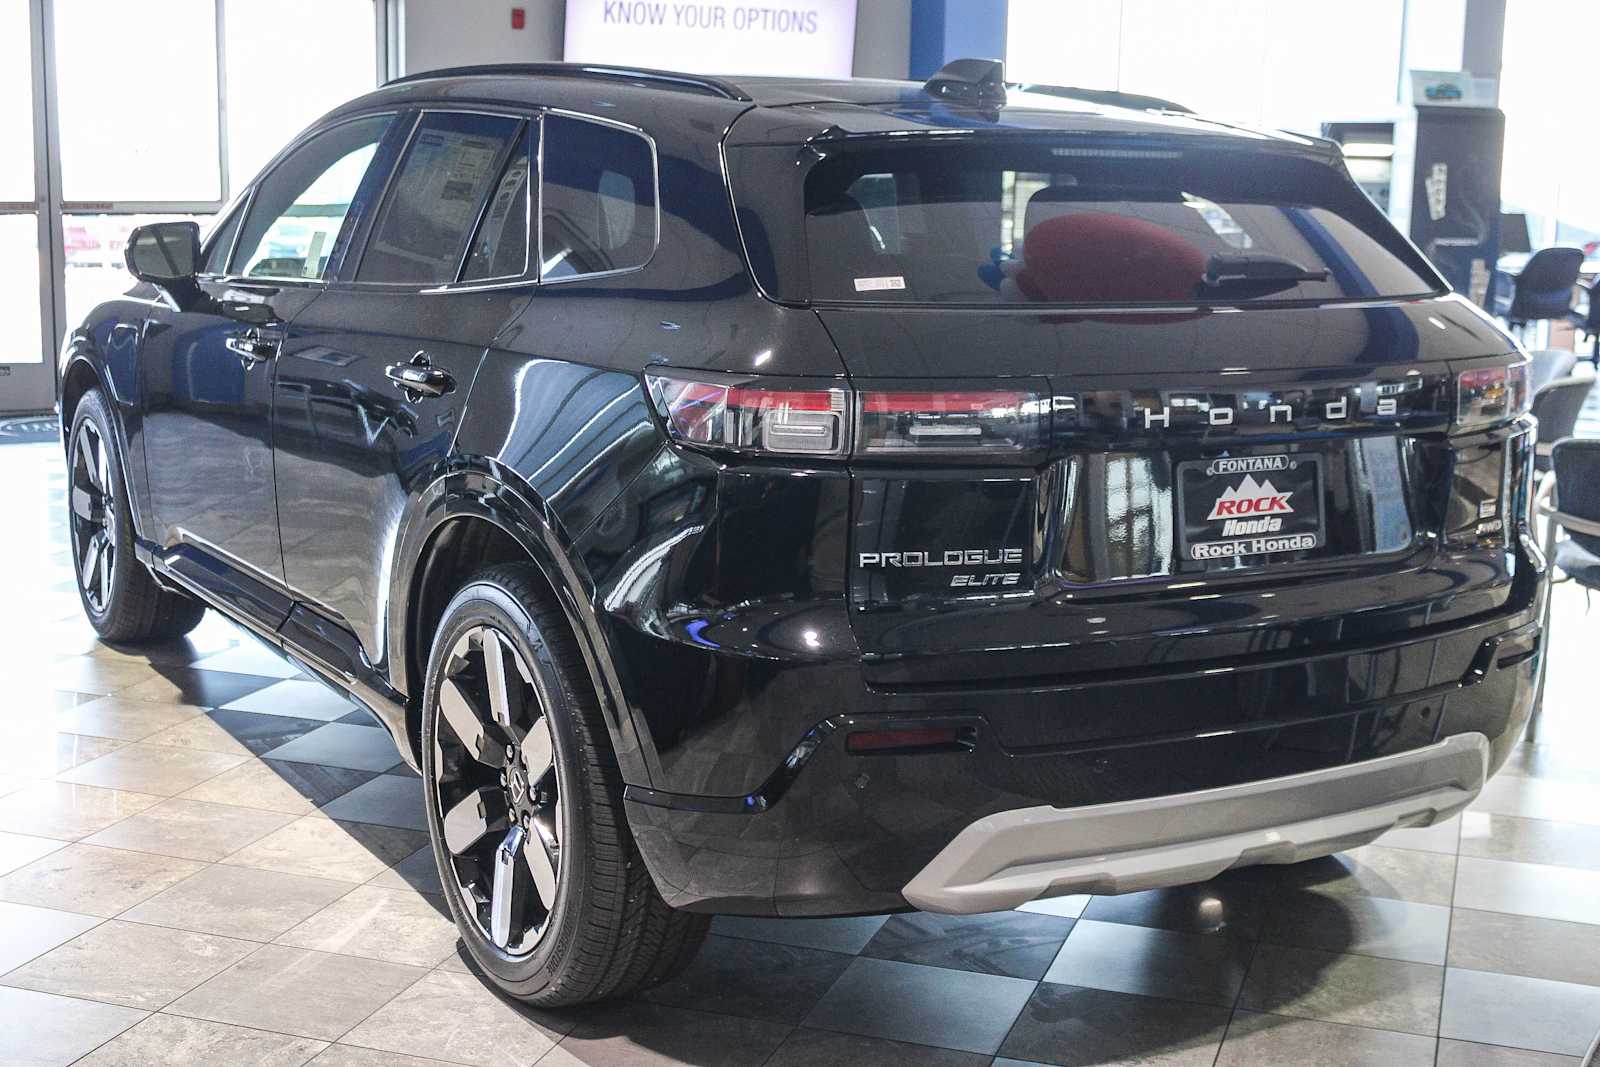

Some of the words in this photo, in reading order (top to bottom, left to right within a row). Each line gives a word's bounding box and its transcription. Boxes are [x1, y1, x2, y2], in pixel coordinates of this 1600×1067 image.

[603, 0, 666, 26] KNOW
[672, 4, 727, 29] YOUR
[732, 7, 818, 35] OPTIONS
[1144, 396, 1397, 429] Honda
[1218, 457, 1283, 472] FONTANA
[1215, 496, 1288, 517] ROCK
[1222, 516, 1283, 537] Honda
[859, 548, 1023, 568] PROLOGUE
[1194, 542, 1248, 559] Rock
[1251, 537, 1314, 553] Honda
[949, 572, 1021, 587] ELITE
